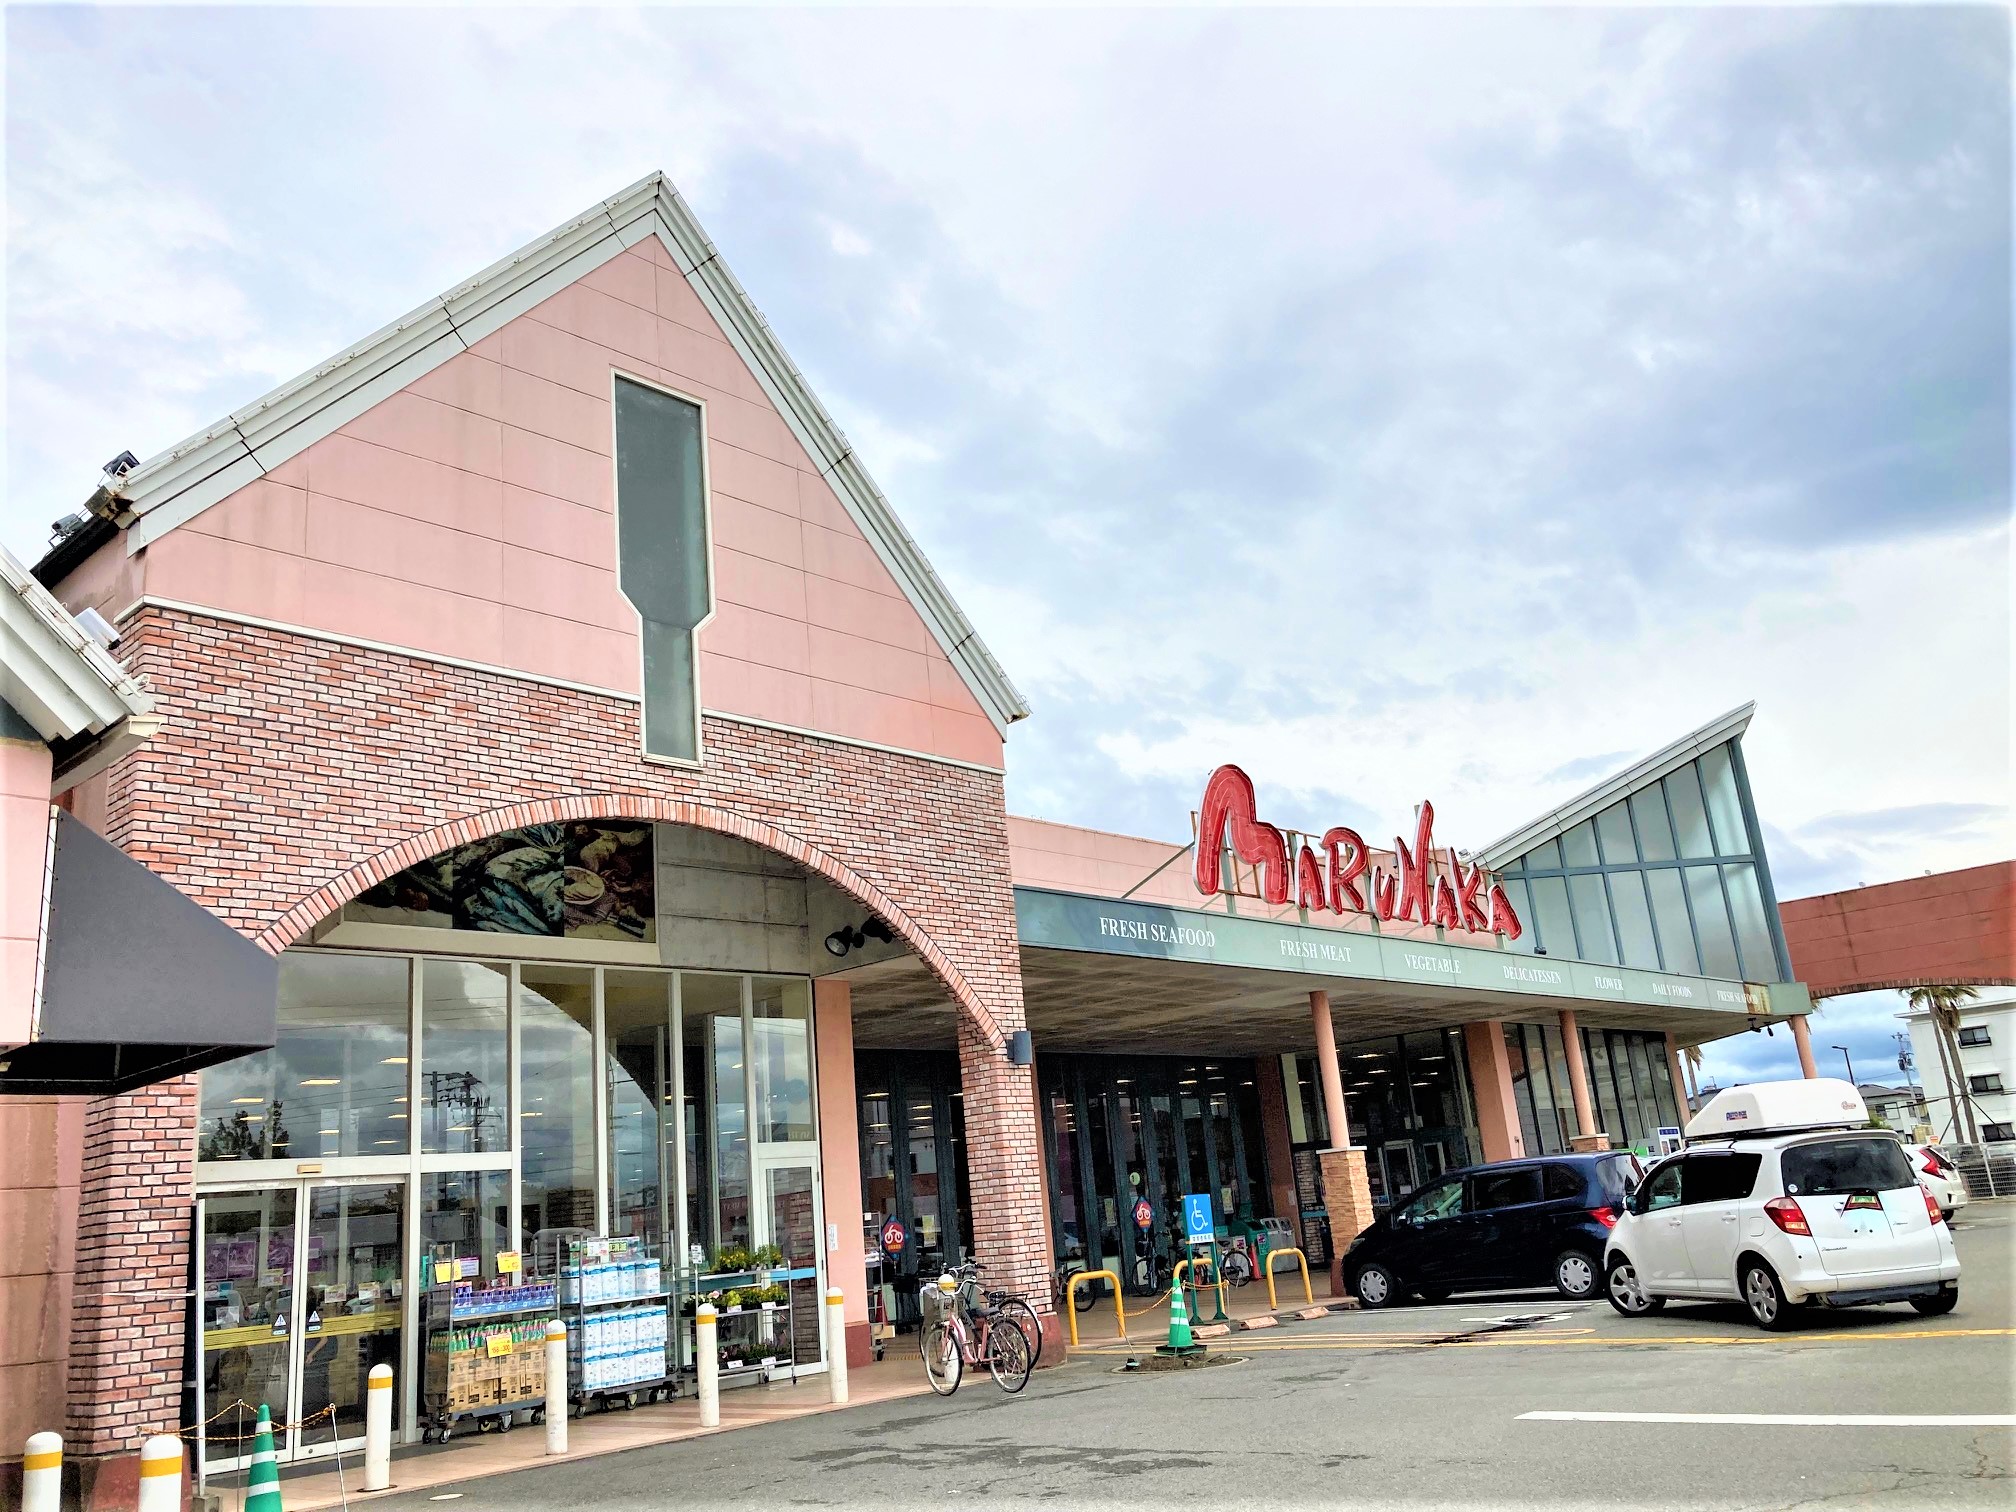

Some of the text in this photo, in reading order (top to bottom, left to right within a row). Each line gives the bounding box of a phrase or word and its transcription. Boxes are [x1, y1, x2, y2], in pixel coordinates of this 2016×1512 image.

[1100, 917, 1216, 947] FRESH SEAFOOD
[1280, 939, 1352, 962] FRESH MEAT
[1404, 953, 1462, 974] VEGETABLE
[1503, 965, 1562, 984] DELICATESSEN
[1594, 976, 1624, 991] FLOWER
[1652, 982, 1693, 998] DAILY FOODS
